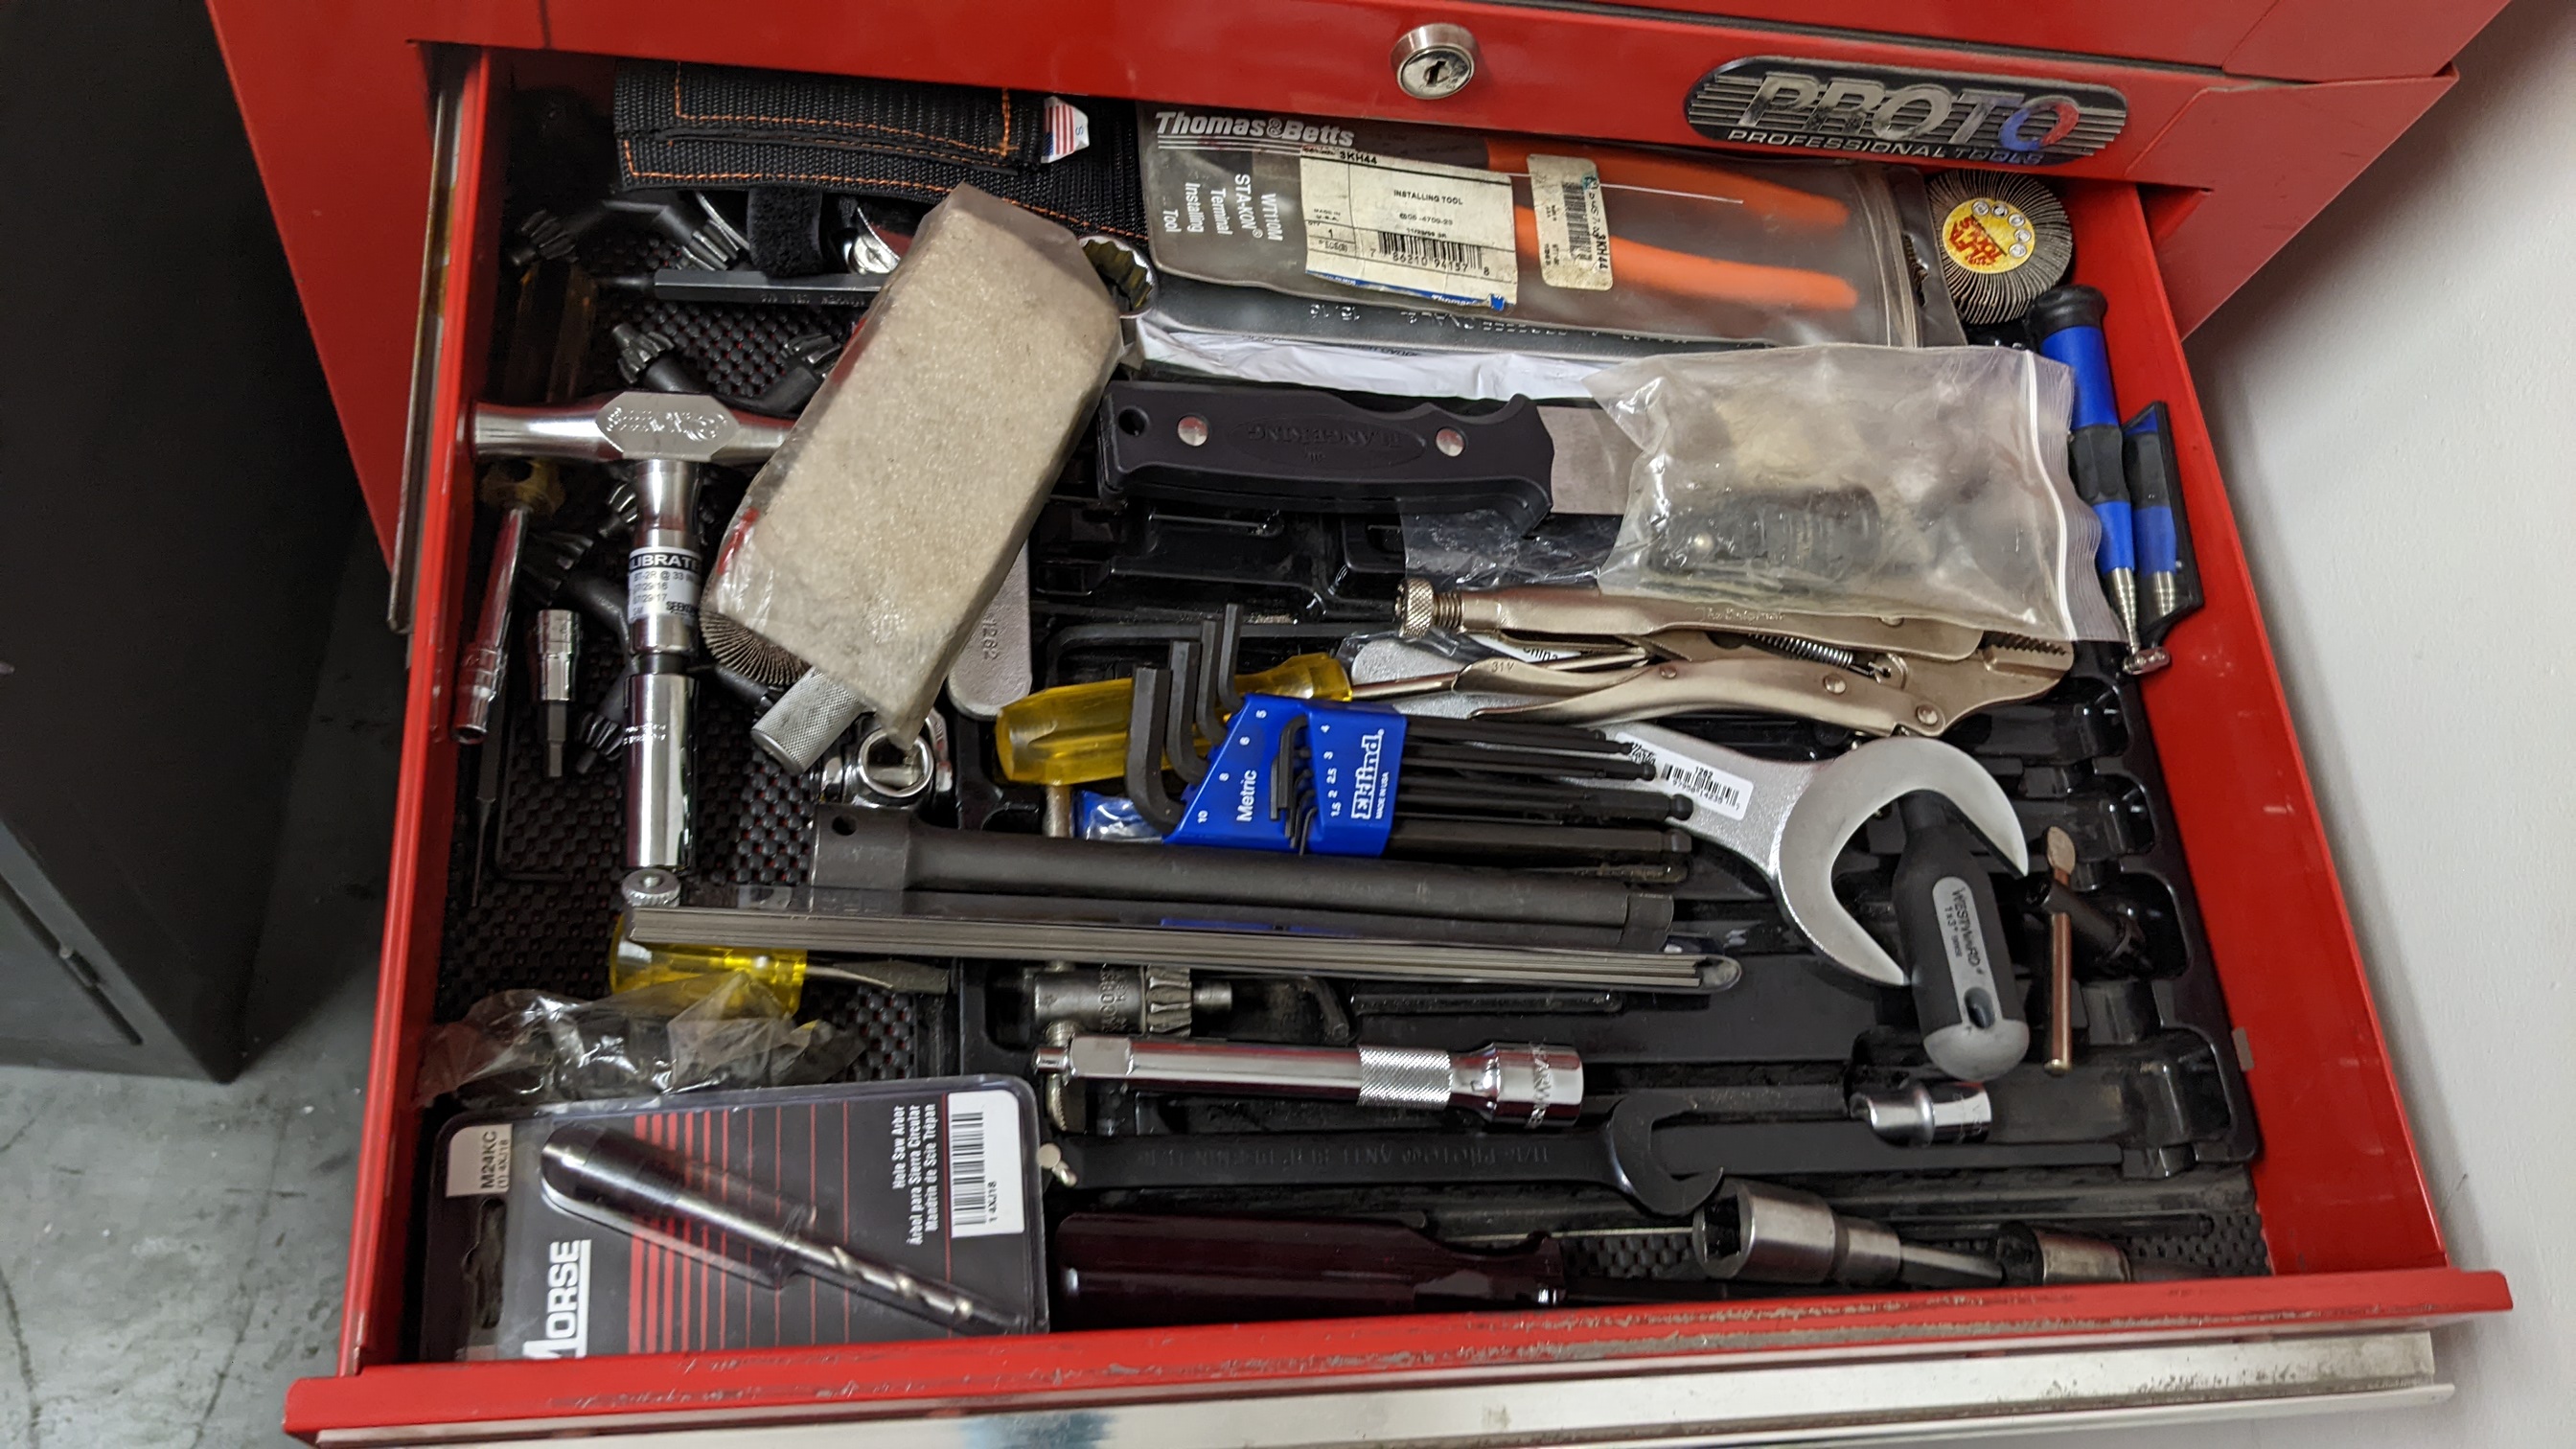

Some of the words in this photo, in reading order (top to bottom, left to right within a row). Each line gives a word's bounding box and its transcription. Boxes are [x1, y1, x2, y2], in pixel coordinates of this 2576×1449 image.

[1736, 71, 2082, 152] PROTO
[1727, 129, 1945, 158] PROFESSIONAL
[1953, 149, 2044, 166] TOOLS
[1185, 182, 1205, 233] Installing
[1210, 188, 1233, 236] Terminal
[1393, 190, 1440, 203] INSTALLING
[1441, 195, 1463, 205] TOOL
[1162, 208, 1182, 233] Tool
[1370, 247, 1377, 257] 7
[1255, 710, 1267, 719] 5
[1351, 734, 1382, 819] Eklind
[1236, 770, 1257, 821] Metric
[1327, 790, 1338, 798] 2
[1197, 810, 1208, 823] 10
[891, 1105, 906, 1136] Arbor
[907, 1105, 921, 1148] Circular
[481, 1130, 498, 1188] M24KC
[891, 1138, 906, 1162] Saw
[923, 1142, 937, 1167] Scie
[892, 1162, 907, 1189] Hole
[908, 1150, 922, 1184] Sierra
[924, 1168, 937, 1184] de
[910, 1186, 925, 1212] para
[924, 1185, 938, 1231] Mandrin
